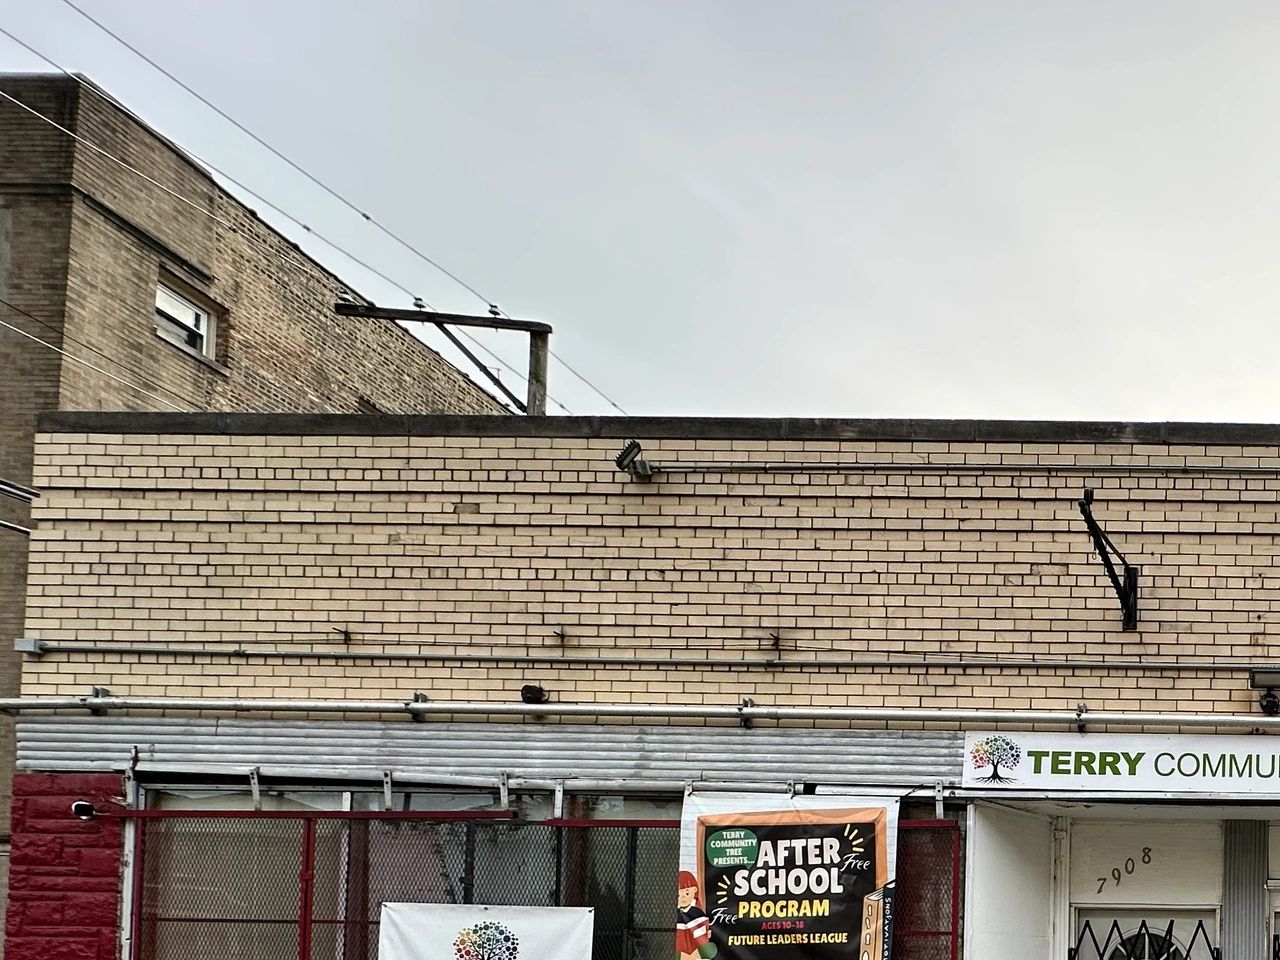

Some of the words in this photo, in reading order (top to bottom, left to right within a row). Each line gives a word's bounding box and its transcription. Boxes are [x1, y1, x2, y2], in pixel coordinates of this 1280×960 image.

[1027, 750, 1146, 776] TERRY
[710, 839, 757, 848] COMMUNITY
[757, 838, 841, 867] AFTER
[840, 853, 871, 872] Free
[1097, 847, 1152, 894] 7908
[733, 868, 844, 896] SCHOOL
[709, 907, 739, 926] Free
[738, 899, 829, 919] PROGRAM
[761, 922, 782, 930] AGES
[728, 935, 765, 946] FUTURE
[767, 934, 808, 945] LEADERS
[810, 933, 848, 944] LEAGUE
